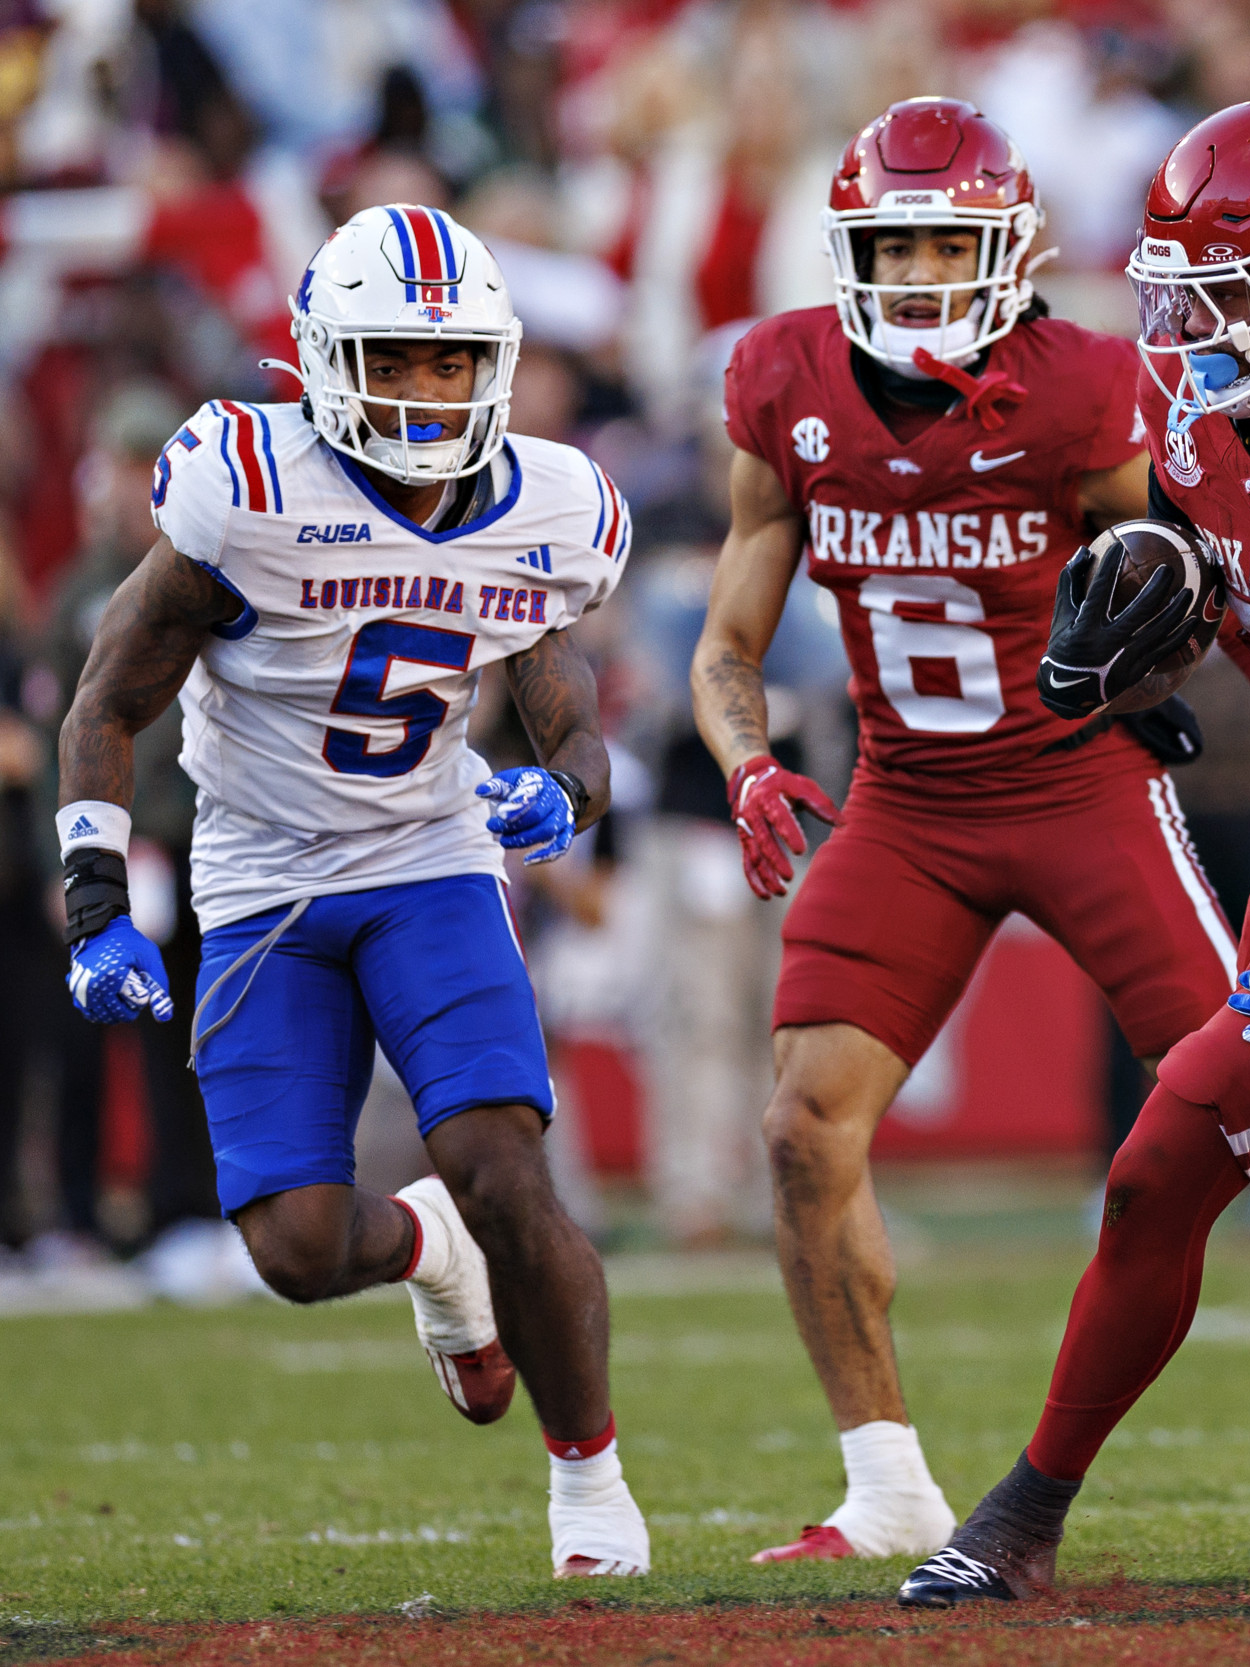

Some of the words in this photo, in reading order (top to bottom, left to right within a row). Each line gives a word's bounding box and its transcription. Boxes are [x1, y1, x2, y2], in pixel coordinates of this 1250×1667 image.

[895, 194, 932, 205] HOGS
[1146, 243, 1171, 258] HOGS
[791, 416, 830, 463] SEC
[1168, 431, 1195, 470] SEC
[300, 576, 464, 614] LOUISIANA
[479, 584, 548, 625] TECH
[858, 573, 1007, 733] 6
[321, 618, 477, 779] 5
[68, 826, 99, 841] adidas
